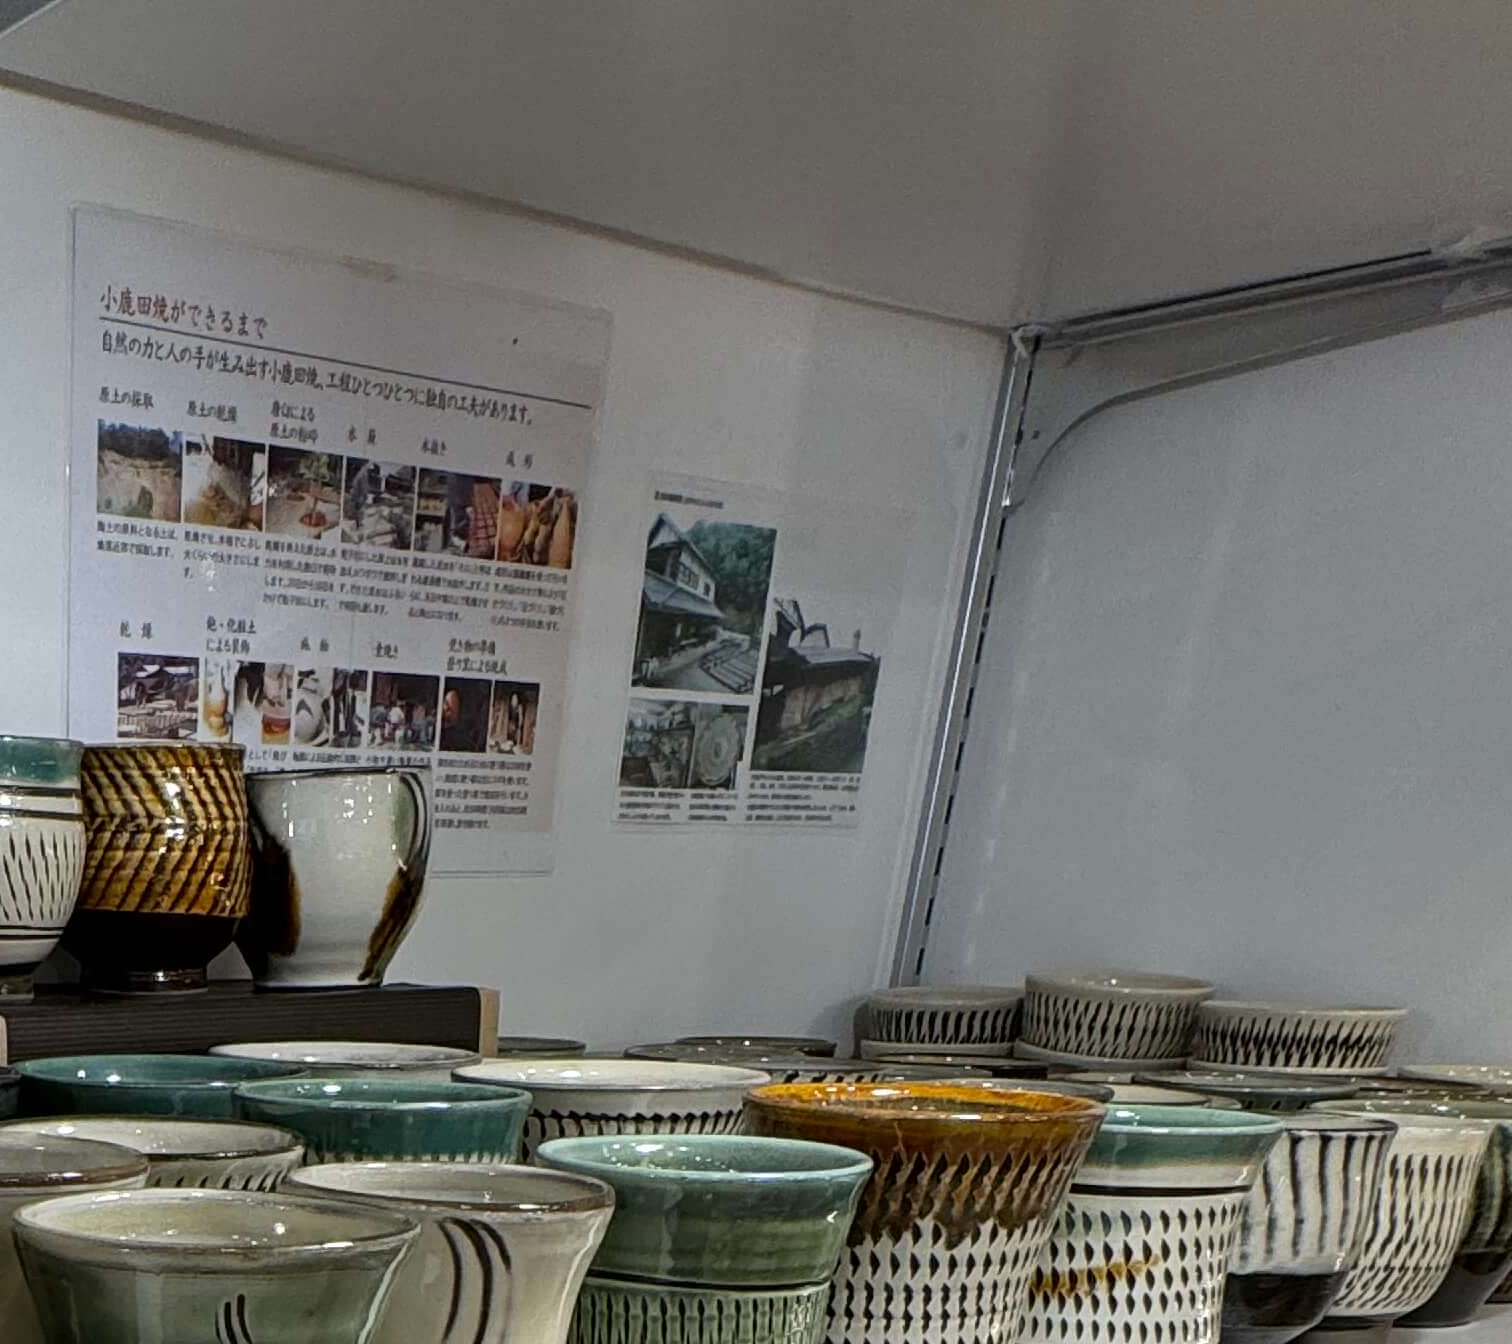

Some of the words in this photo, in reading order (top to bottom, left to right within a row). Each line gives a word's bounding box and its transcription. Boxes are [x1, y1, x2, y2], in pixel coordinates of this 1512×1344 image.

[100, 284, 268, 340] 小鹿田焼ができるまで
